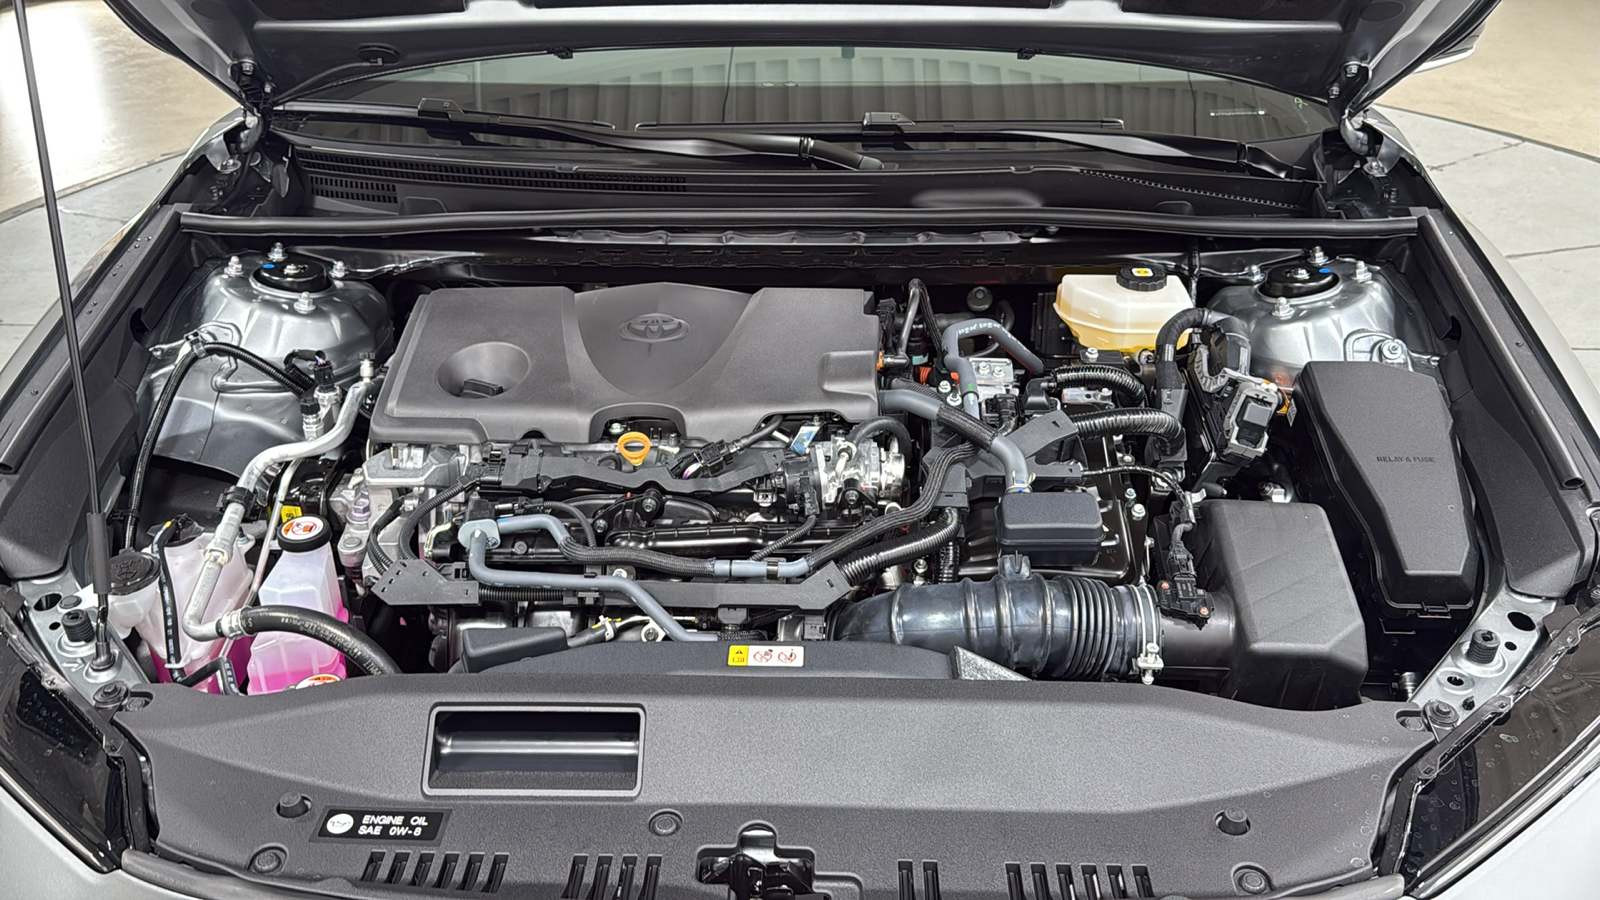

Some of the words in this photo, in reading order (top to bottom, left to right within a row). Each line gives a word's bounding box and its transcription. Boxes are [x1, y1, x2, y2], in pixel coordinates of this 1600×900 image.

[362, 814, 404, 826] ENGINE
[410, 816, 429, 826] OIL
[358, 825, 382, 836] SAE
[389, 827, 422, 837] 0W-8
